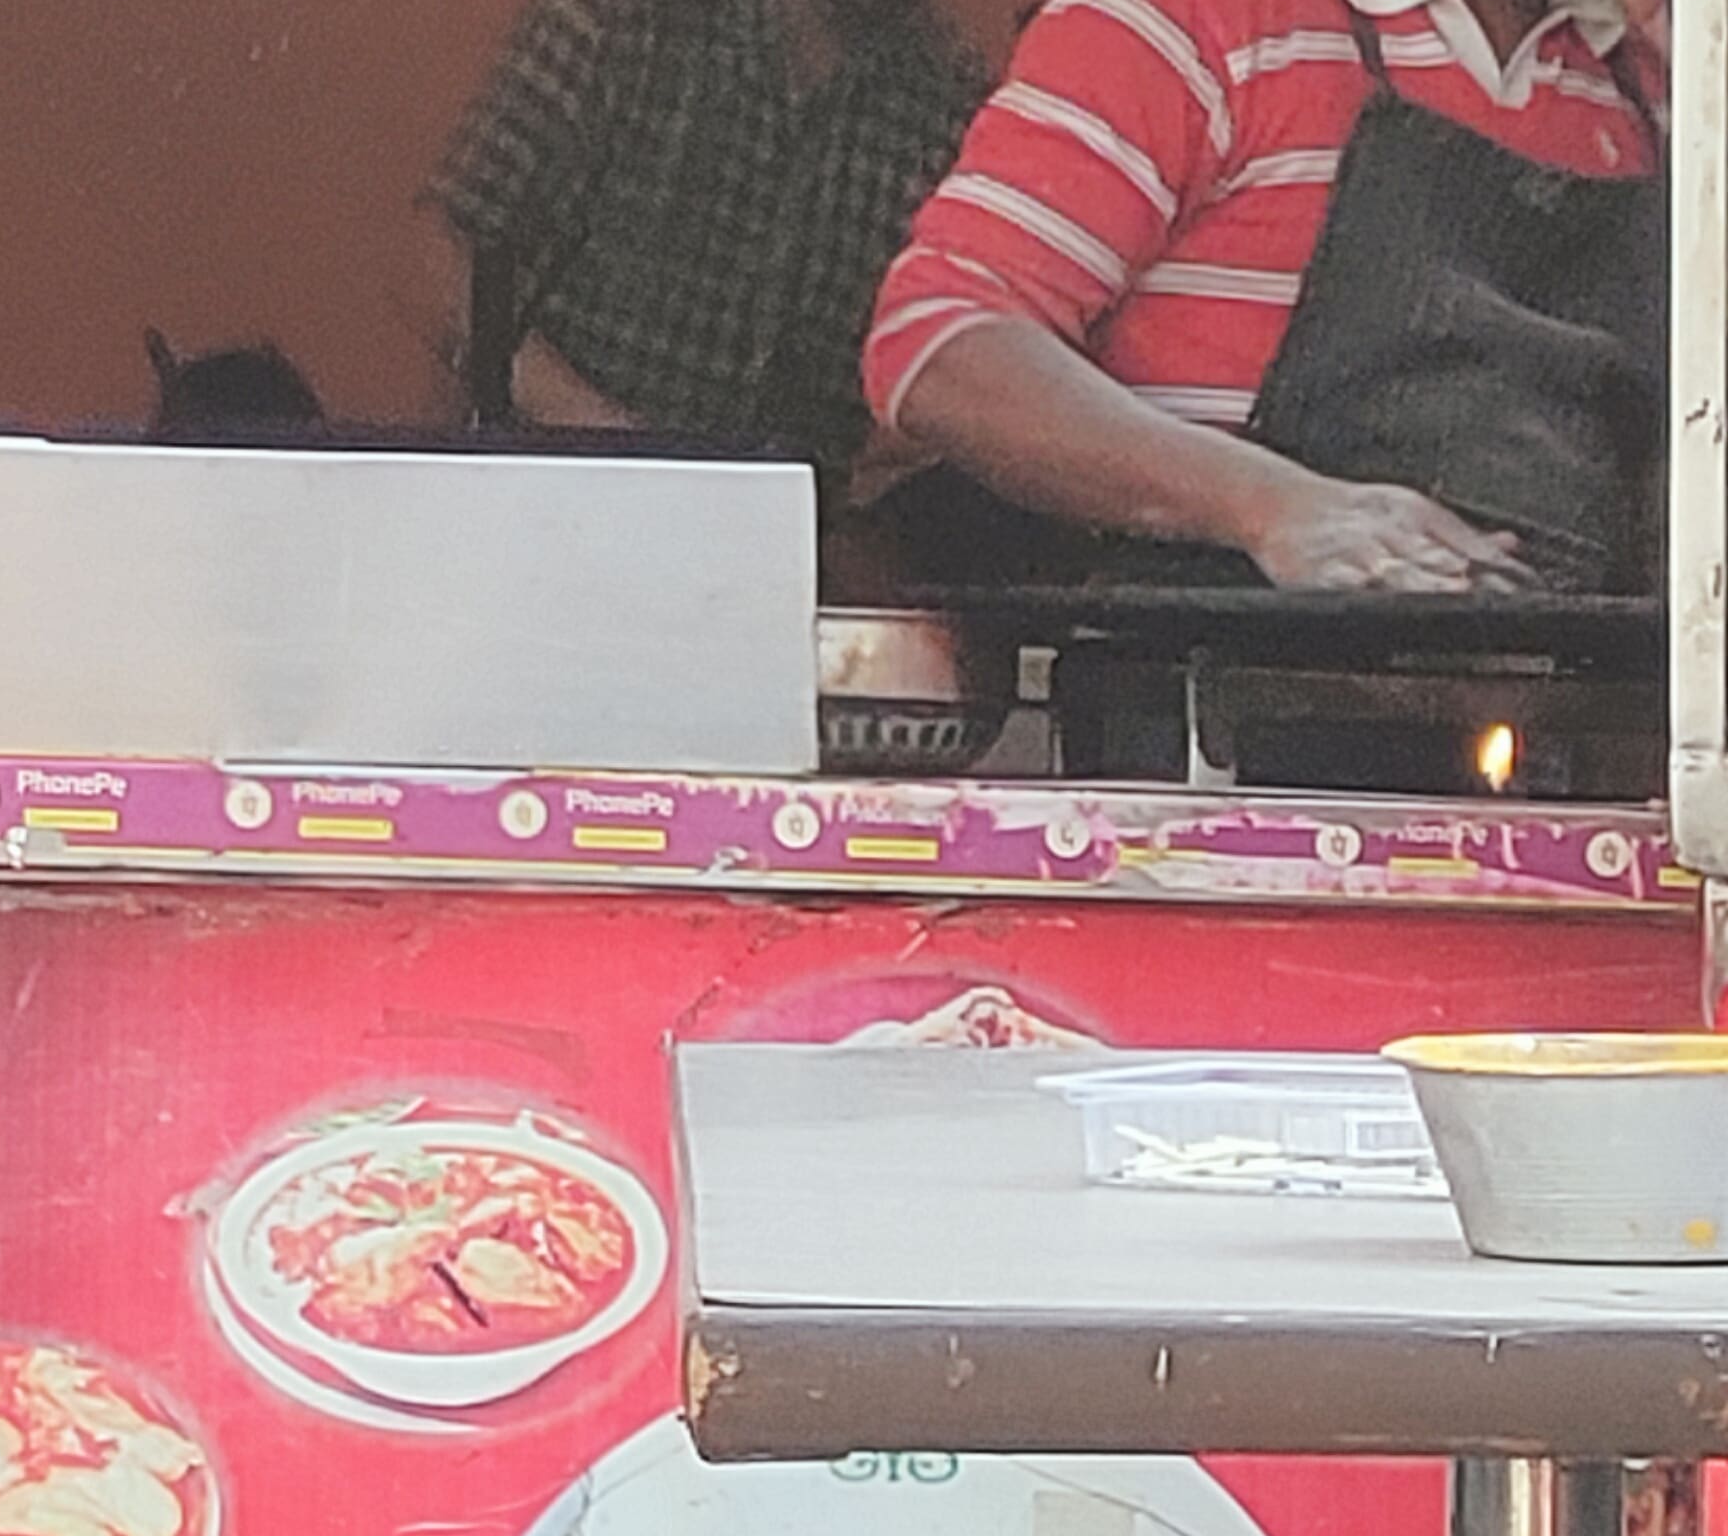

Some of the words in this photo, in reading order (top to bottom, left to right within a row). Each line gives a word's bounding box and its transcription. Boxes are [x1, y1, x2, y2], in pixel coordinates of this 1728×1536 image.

[16, 769, 127, 798] PhonePe
[292, 780, 404, 807] PhonePe
[565, 788, 674, 818] PhonePe
